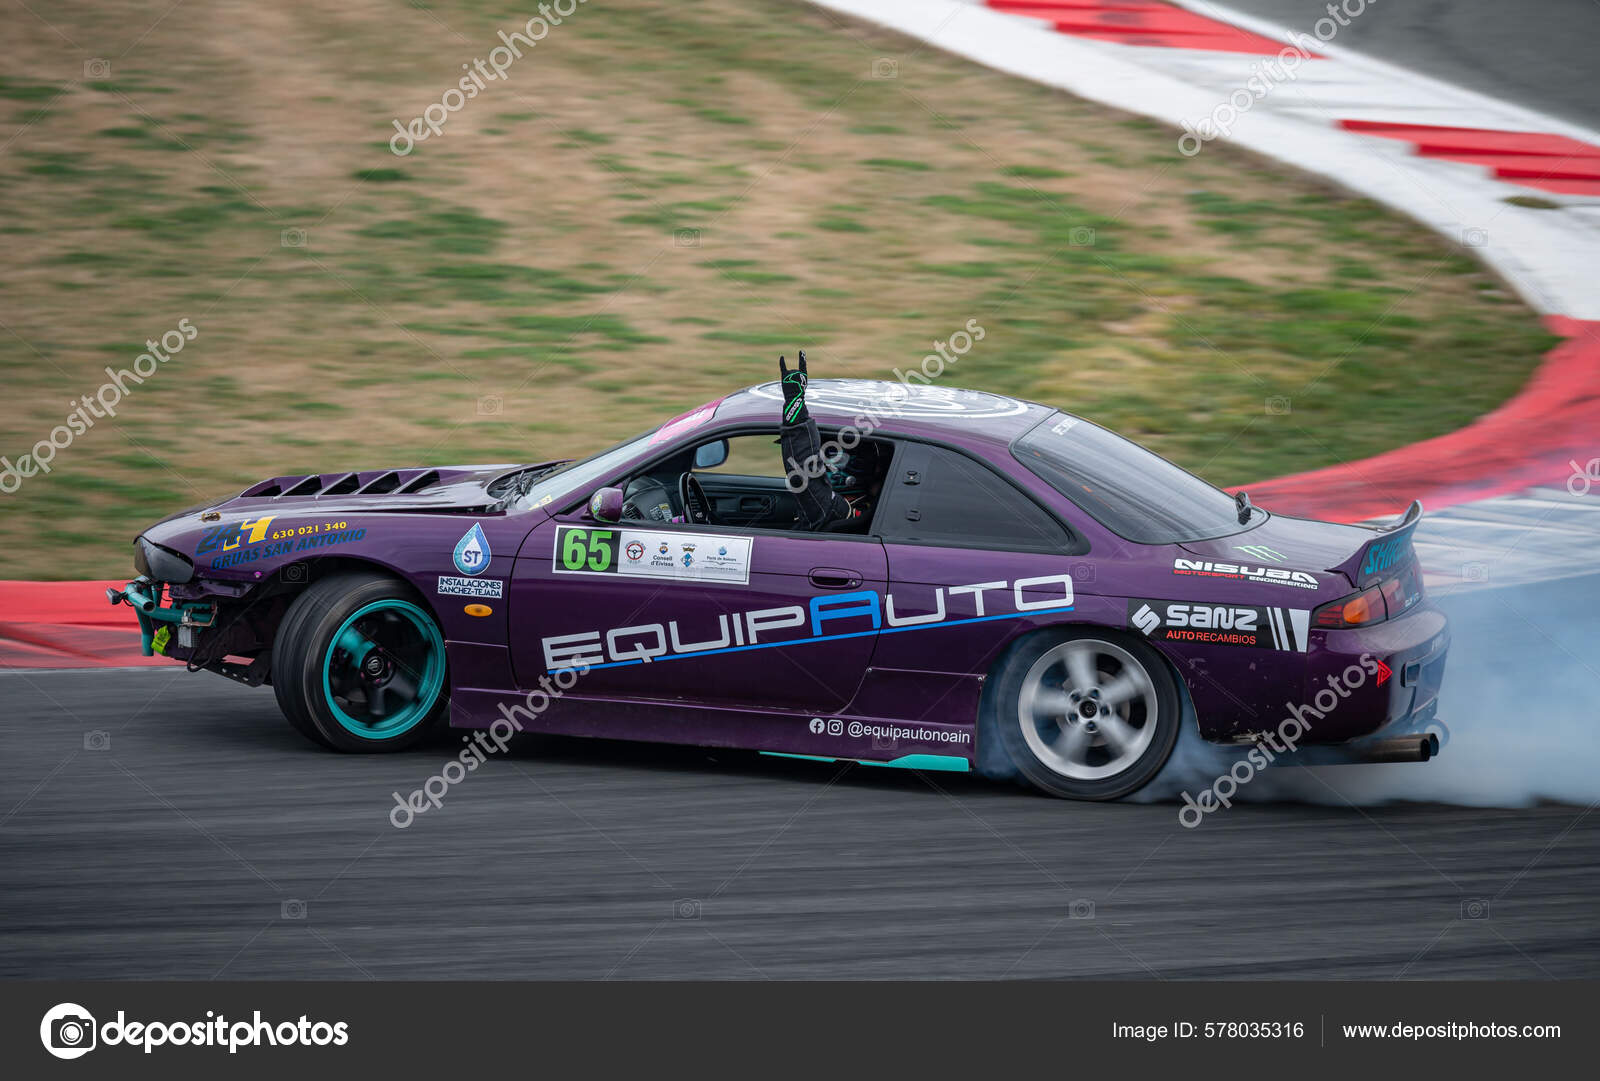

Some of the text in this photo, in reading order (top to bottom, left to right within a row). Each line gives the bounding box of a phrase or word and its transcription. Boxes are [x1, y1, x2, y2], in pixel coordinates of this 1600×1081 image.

[272, 521, 347, 540] 630 021 340
[211, 528, 367, 571] GRUAS SAN ANTONIO
[463, 550, 481, 564] ST
[562, 529, 612, 572] 65
[1173, 569, 1318, 590] MOTORSPORT ENGINEERING
[1174, 558, 1319, 585] NISUBA
[439, 585, 501, 597] SANCHEZ-TEJADA
[440, 577, 502, 590] INSTALACIONES
[1166, 630, 1195, 640] AUTO
[848, 721, 970, 743] @equipautonoain
